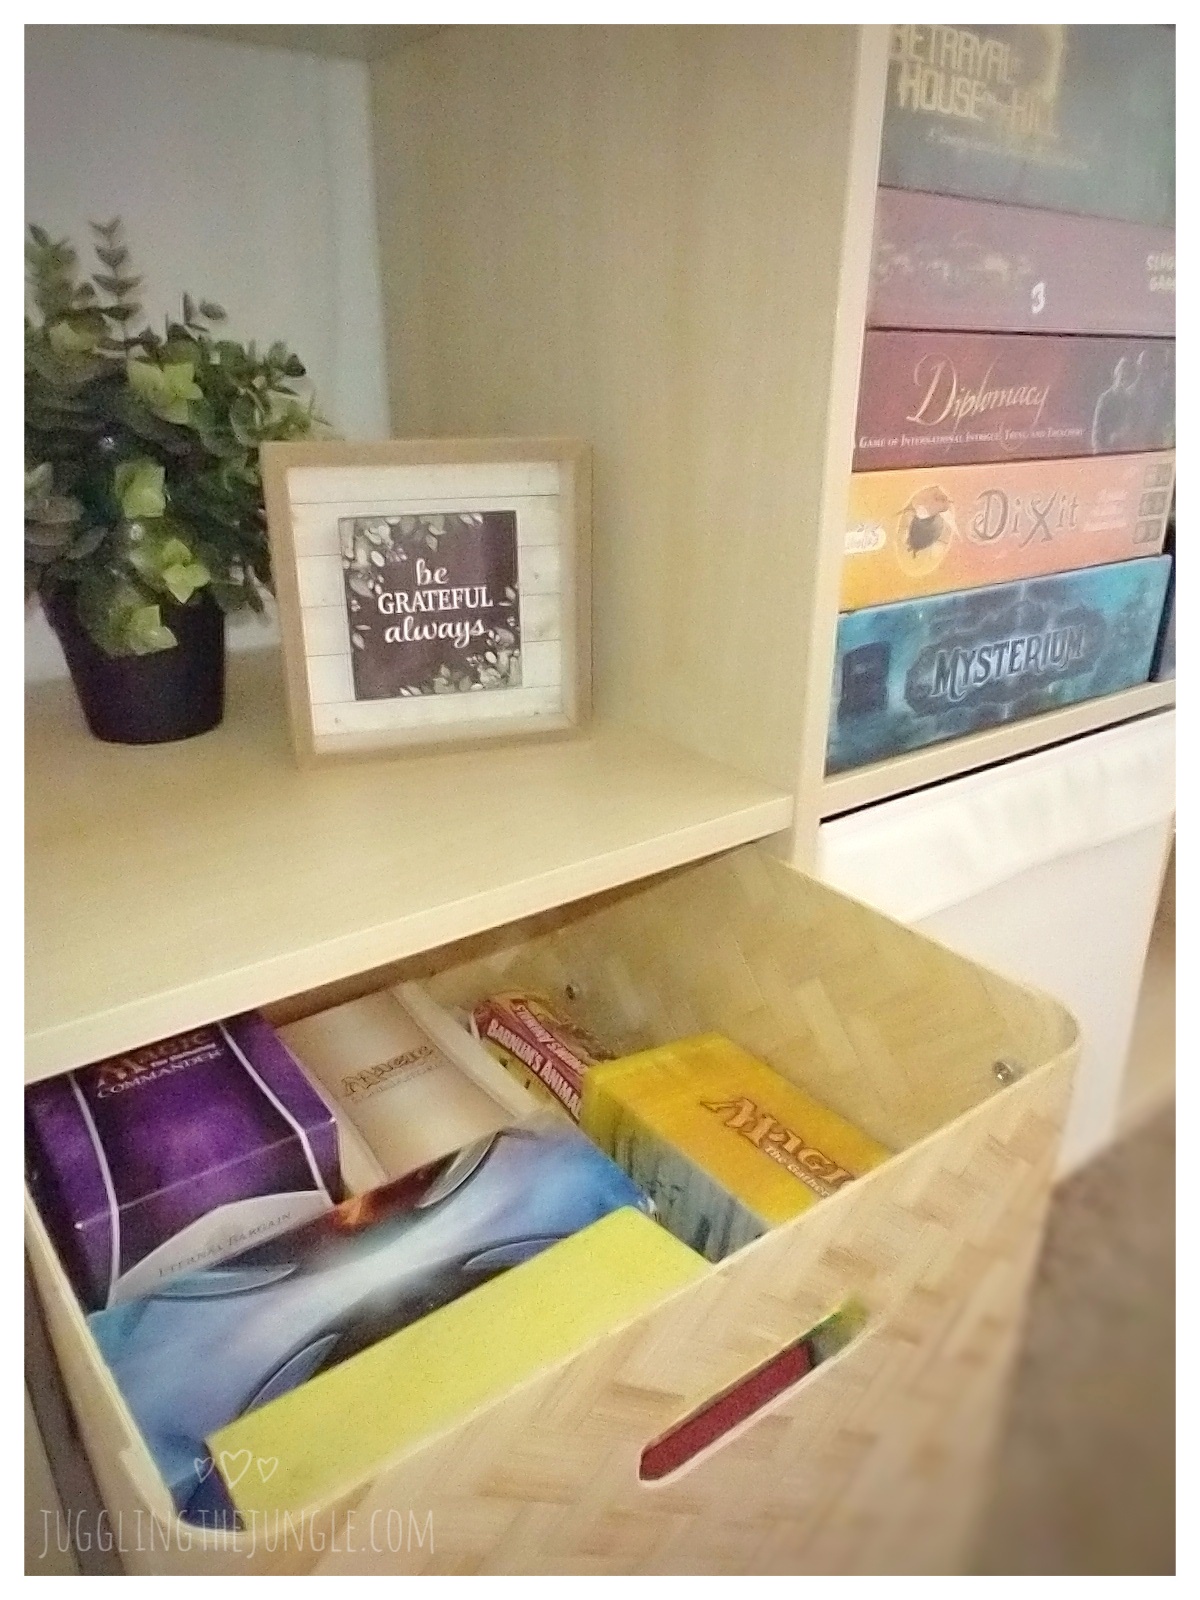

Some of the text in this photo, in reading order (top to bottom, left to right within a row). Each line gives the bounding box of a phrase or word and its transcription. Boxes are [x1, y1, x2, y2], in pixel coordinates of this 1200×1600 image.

[898, 60, 985, 122] HOUSE
[1030, 281, 1046, 314] 3
[906, 352, 1051, 448] Diplomacy
[415, 557, 449, 586] be
[377, 586, 494, 615] GRATEFUL
[384, 615, 487, 649] always
[931, 623, 1086, 703] MYSTERIUM
[97, 1046, 225, 1098] COMMANDER
